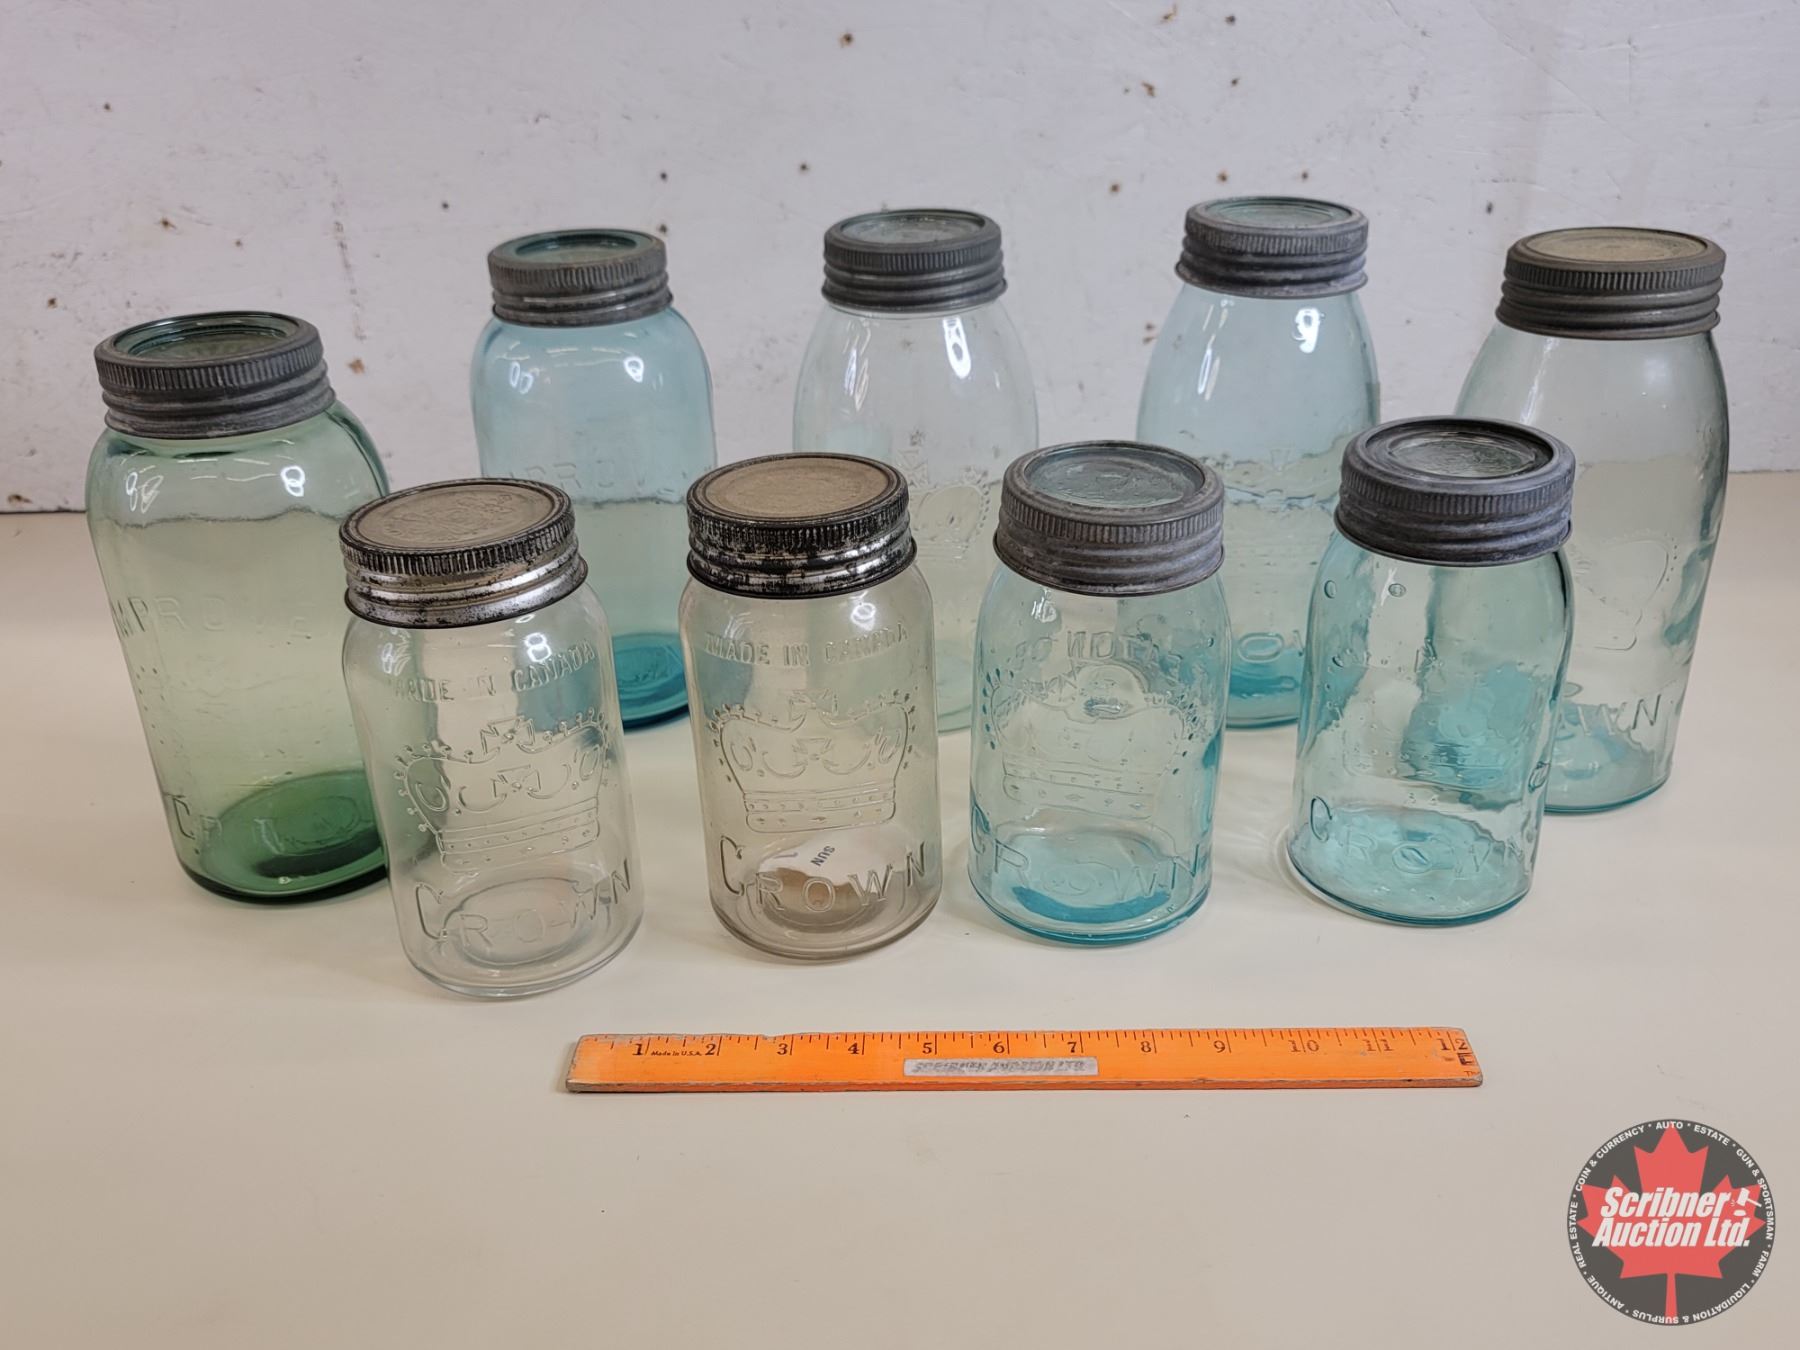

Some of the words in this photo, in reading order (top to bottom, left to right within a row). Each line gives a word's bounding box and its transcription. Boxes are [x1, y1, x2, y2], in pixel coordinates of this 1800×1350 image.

[510, 639, 597, 693] CANADA
[704, 631, 771, 666] MADE
[783, 642, 810, 667] IN
[824, 621, 909, 666] CANADA
[719, 835, 926, 913] CROWN
[810, 845, 836, 867] SUN
[415, 857, 631, 953] CROWN
[632, 1043, 643, 1056] 1
[705, 1043, 717, 1056] 2
[777, 1043, 788, 1056] 3
[848, 1043, 860, 1055] 4
[922, 1042, 932, 1054] 5
[993, 1041, 1005, 1054] 6
[1067, 1041, 1077, 1054] 7
[1140, 1041, 1152, 1054] 8
[1213, 1040, 1226, 1054] 9
[1290, 1039, 1320, 1053] 10
[1364, 1039, 1394, 1053] 11
[1436, 1038, 1468, 1050] 12
